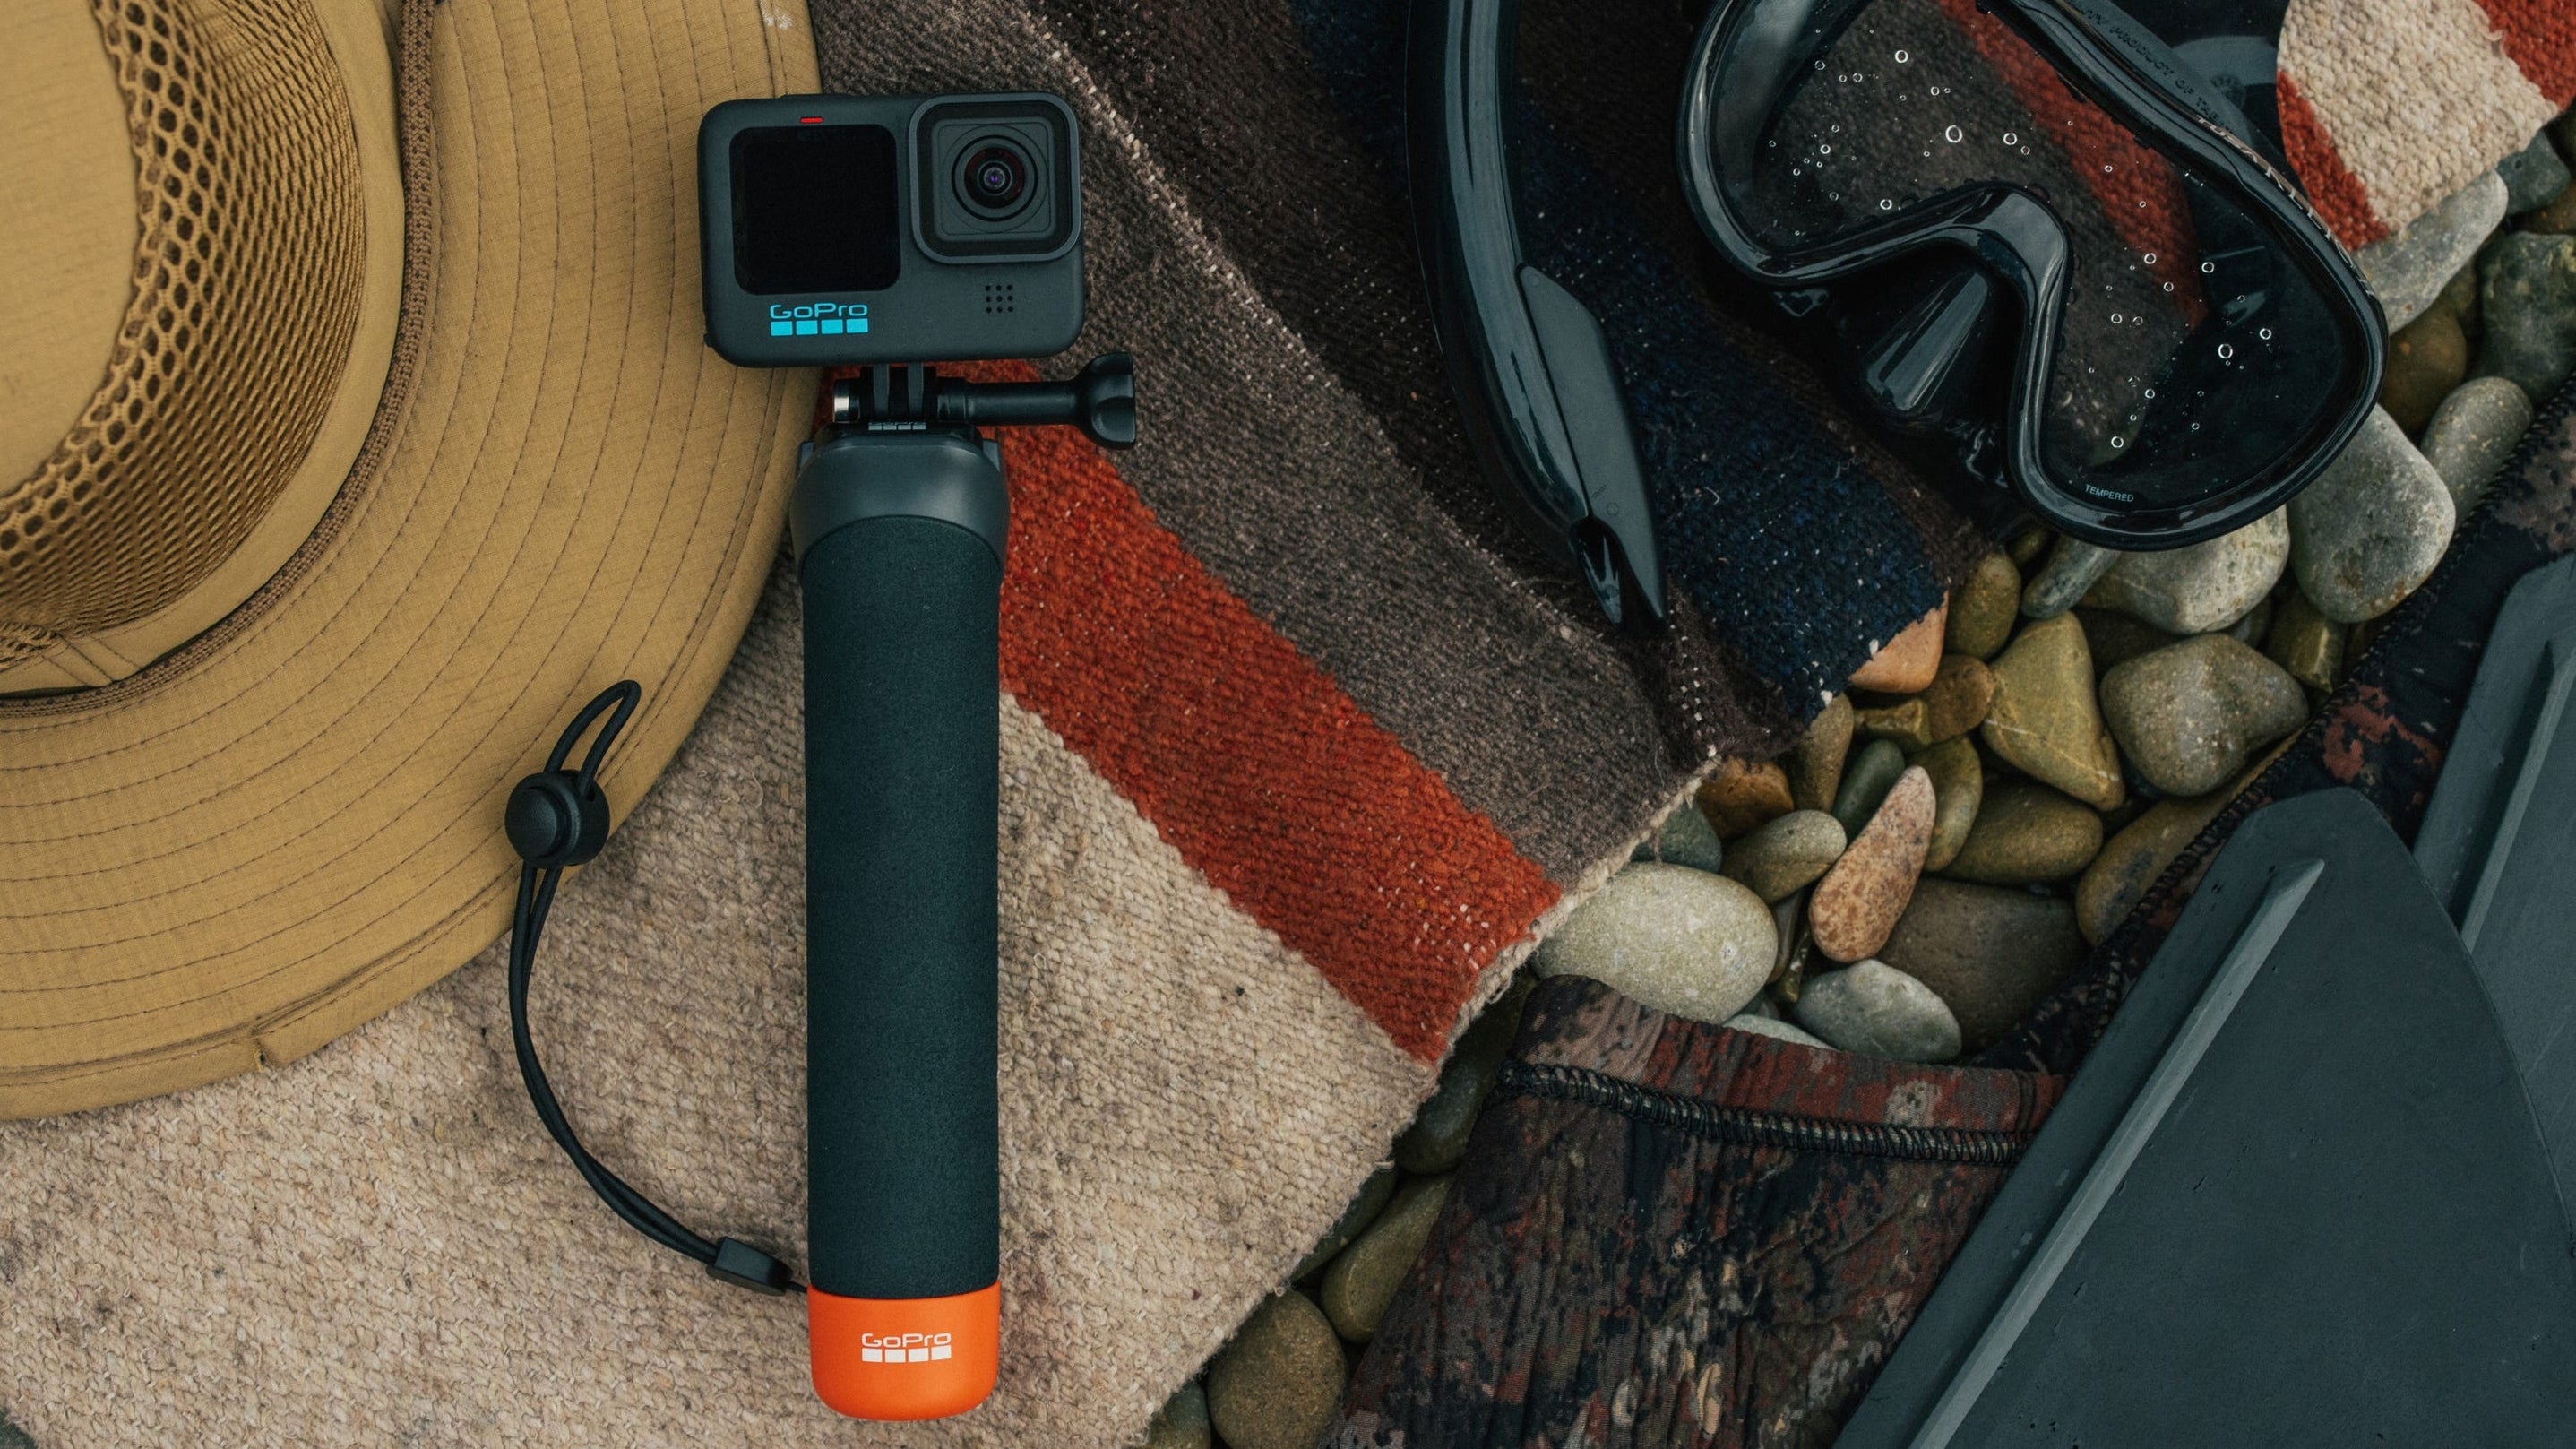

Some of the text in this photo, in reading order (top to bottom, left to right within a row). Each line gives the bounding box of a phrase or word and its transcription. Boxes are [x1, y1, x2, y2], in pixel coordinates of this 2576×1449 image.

[2109, 25, 2175, 76] PRODUCT
[2175, 79, 2194, 94] OF
[770, 303, 868, 319] GoPro
[2085, 485, 2134, 502] TEMPERED
[861, 1333, 952, 1349] GoPro
